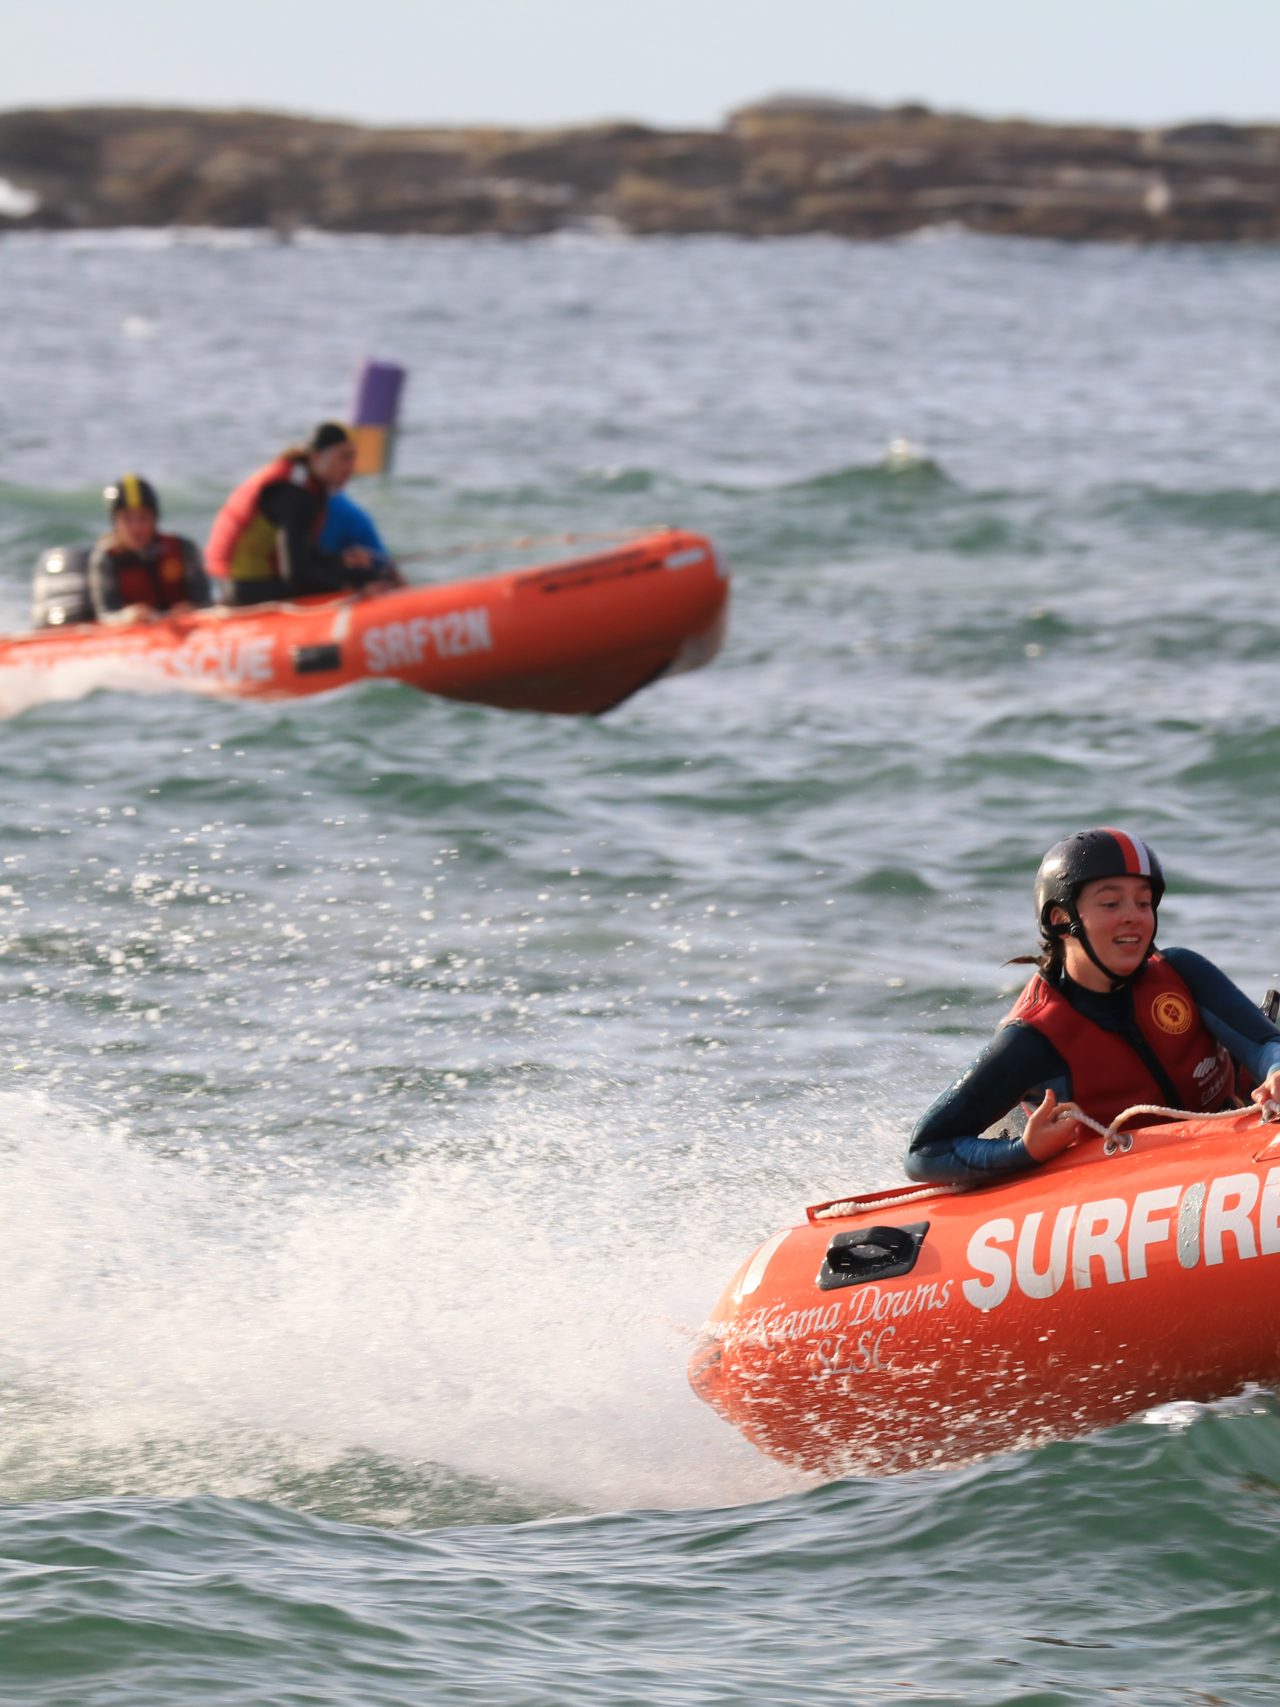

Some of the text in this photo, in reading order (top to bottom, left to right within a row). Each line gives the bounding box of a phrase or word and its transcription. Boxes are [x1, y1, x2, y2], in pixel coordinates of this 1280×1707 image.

[363, 607, 492, 673] SRF12N
[962, 1183, 1184, 1311] SURF
[848, 1279, 955, 1327] Downs
